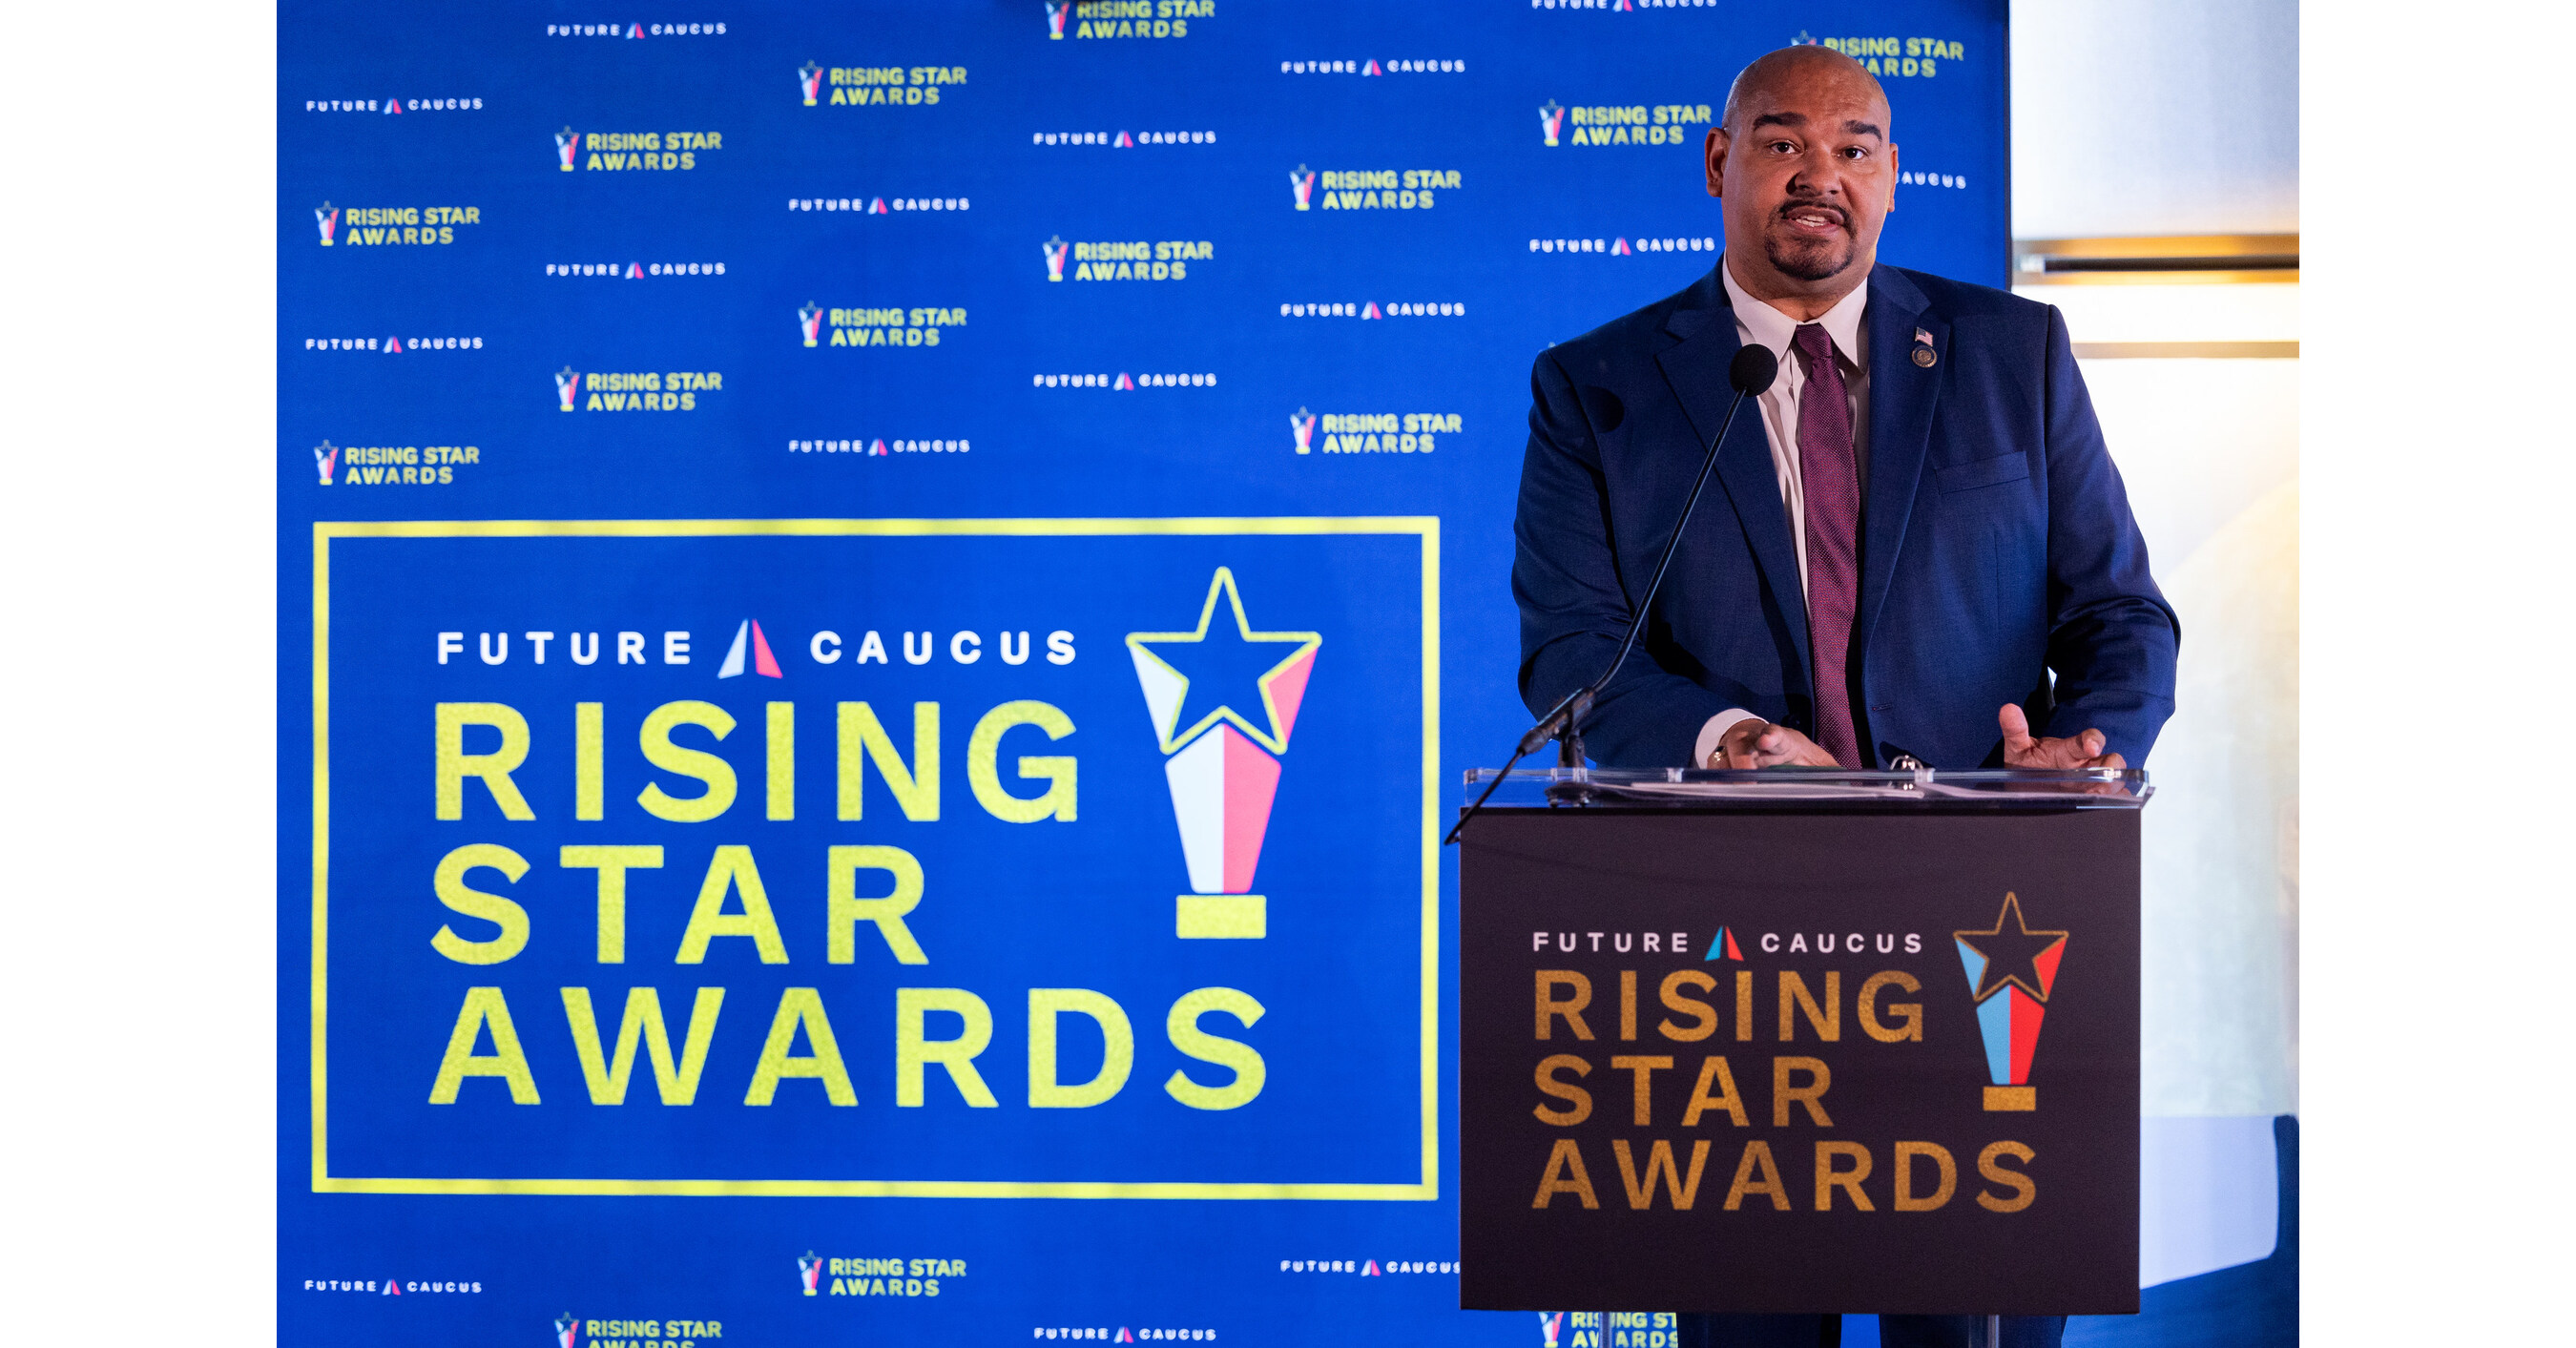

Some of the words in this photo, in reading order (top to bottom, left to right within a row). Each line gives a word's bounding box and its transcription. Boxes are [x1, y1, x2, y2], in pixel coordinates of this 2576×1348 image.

[1077, 1, 1152, 18] RISING
[1157, 0, 1215, 17] STAR
[548, 25, 619, 36] FUTURE
[651, 23, 726, 35] CAUCUS
[1077, 20, 1187, 38] AWARDS
[1905, 37, 1963, 61] STAR
[1281, 61, 1356, 73] FUTURE
[1387, 60, 1465, 73] CAUCUS
[1859, 58, 1936, 77] ARDS
[830, 68, 904, 85] RISING
[910, 67, 966, 85] STAR
[306, 100, 376, 112] FUTURE
[408, 98, 482, 110] CAUCUS
[830, 87, 939, 105] AWARDS
[1571, 106, 1648, 125] RISING
[1653, 105, 1711, 124] STAR
[587, 133, 659, 151] RISING
[666, 133, 721, 150] STAR
[1033, 133, 1107, 145] FUTURE
[1139, 131, 1215, 144] CAUCUS
[1572, 126, 1683, 145] AWARDS
[588, 153, 695, 170] AWARDS
[1322, 170, 1398, 190] RISING
[1403, 170, 1461, 191] STAR
[1895, 171, 1966, 189] AUCUS
[789, 198, 862, 211] FUTURE
[893, 198, 969, 211] CAUCUS
[1322, 190, 1434, 209] AWARDS
[346, 208, 419, 225] RISING
[425, 207, 479, 224] STAR
[347, 227, 453, 245] AWARDS
[1075, 241, 1151, 260] RISING
[1155, 241, 1213, 259] STAR
[1529, 239, 1605, 253] FUTURE
[1636, 238, 1714, 252] CAUCUS
[547, 264, 618, 276] FUTURE
[650, 263, 725, 275] CAUCUS
[1075, 261, 1186, 280] AWARDS
[830, 308, 904, 326] RISING
[910, 308, 966, 326] STAR
[1280, 303, 1356, 317] FUTURE
[1386, 302, 1465, 316] CAUCUS
[306, 339, 377, 350] FUTURE
[408, 338, 483, 349] CAUCUS
[831, 328, 939, 346] AWARDS
[587, 373, 660, 391] RISING
[666, 372, 721, 390] STAR
[1034, 374, 1108, 387] FUTURE
[1139, 373, 1216, 386] CAUCUS
[587, 392, 696, 411] AWARDS
[1322, 414, 1399, 433] RISING
[1403, 414, 1462, 434] STAR
[789, 440, 862, 452] FUTURE
[893, 440, 969, 452] CAUCUS
[1322, 433, 1434, 453] AWARDS
[345, 447, 418, 465] RISING
[424, 446, 479, 465] STAR
[345, 467, 452, 485] AWARDS
[438, 632, 690, 665] FUTURE
[811, 631, 1075, 665] CAUCUS
[435, 700, 1077, 823] RISING
[431, 843, 928, 965] STAR
[1533, 932, 1688, 952] FUTURE
[1761, 933, 1922, 954] CAUCUS
[1535, 969, 1922, 1043] RISING
[428, 986, 1266, 1110] AWARDS
[1533, 1054, 1834, 1127] STAR
[1532, 1139, 2036, 1213] AWARDS
[830, 1258, 904, 1275] RISING
[910, 1259, 966, 1276] STAR
[1280, 1260, 1355, 1273] FUTURE
[305, 1280, 376, 1291] FUTURE
[407, 1281, 481, 1293] CAUCUS
[830, 1278, 939, 1296] AWARDS
[587, 1320, 659, 1338] RISING
[666, 1320, 721, 1338] STAR
[1034, 1328, 1108, 1339] FUTURE
[1139, 1329, 1215, 1340] CAUCUS
